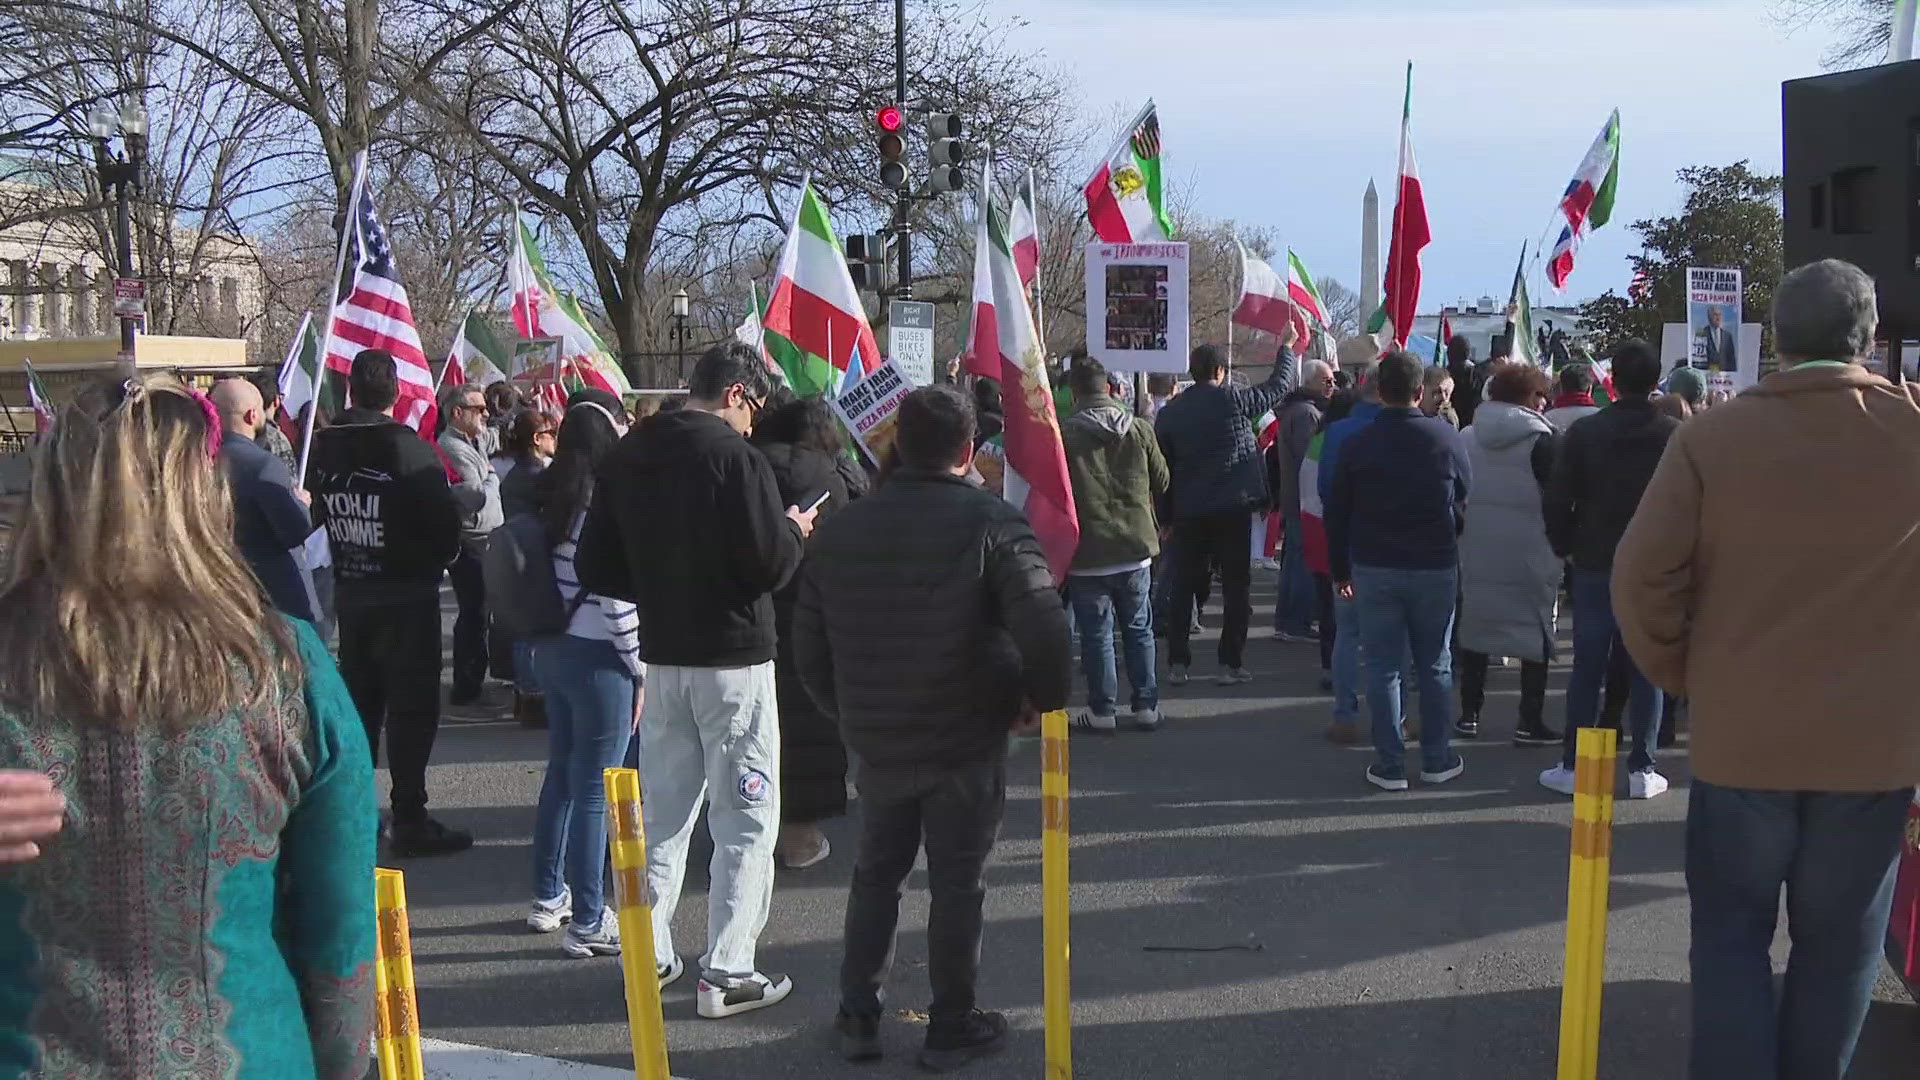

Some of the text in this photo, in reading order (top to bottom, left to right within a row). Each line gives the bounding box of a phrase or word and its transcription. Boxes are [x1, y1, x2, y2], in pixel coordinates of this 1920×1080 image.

[1691, 271, 1737, 282] MAKE IRAN
[1691, 281, 1737, 291] GREAT AGAIN
[1691, 293, 1708, 302] REZA
[903, 306, 921, 315] RIGHT
[904, 317, 921, 326] LANE
[898, 331, 925, 341] BUSES
[898, 342, 925, 352] BIKES
[899, 351, 924, 361] ONLY
[838, 364, 896, 411] MAKE IRAN
[846, 375, 903, 420] GREAT AGAIN
[856, 412, 880, 432] REZA
[322, 493, 380, 519] YOHJI
[327, 518, 385, 548] HOMME
